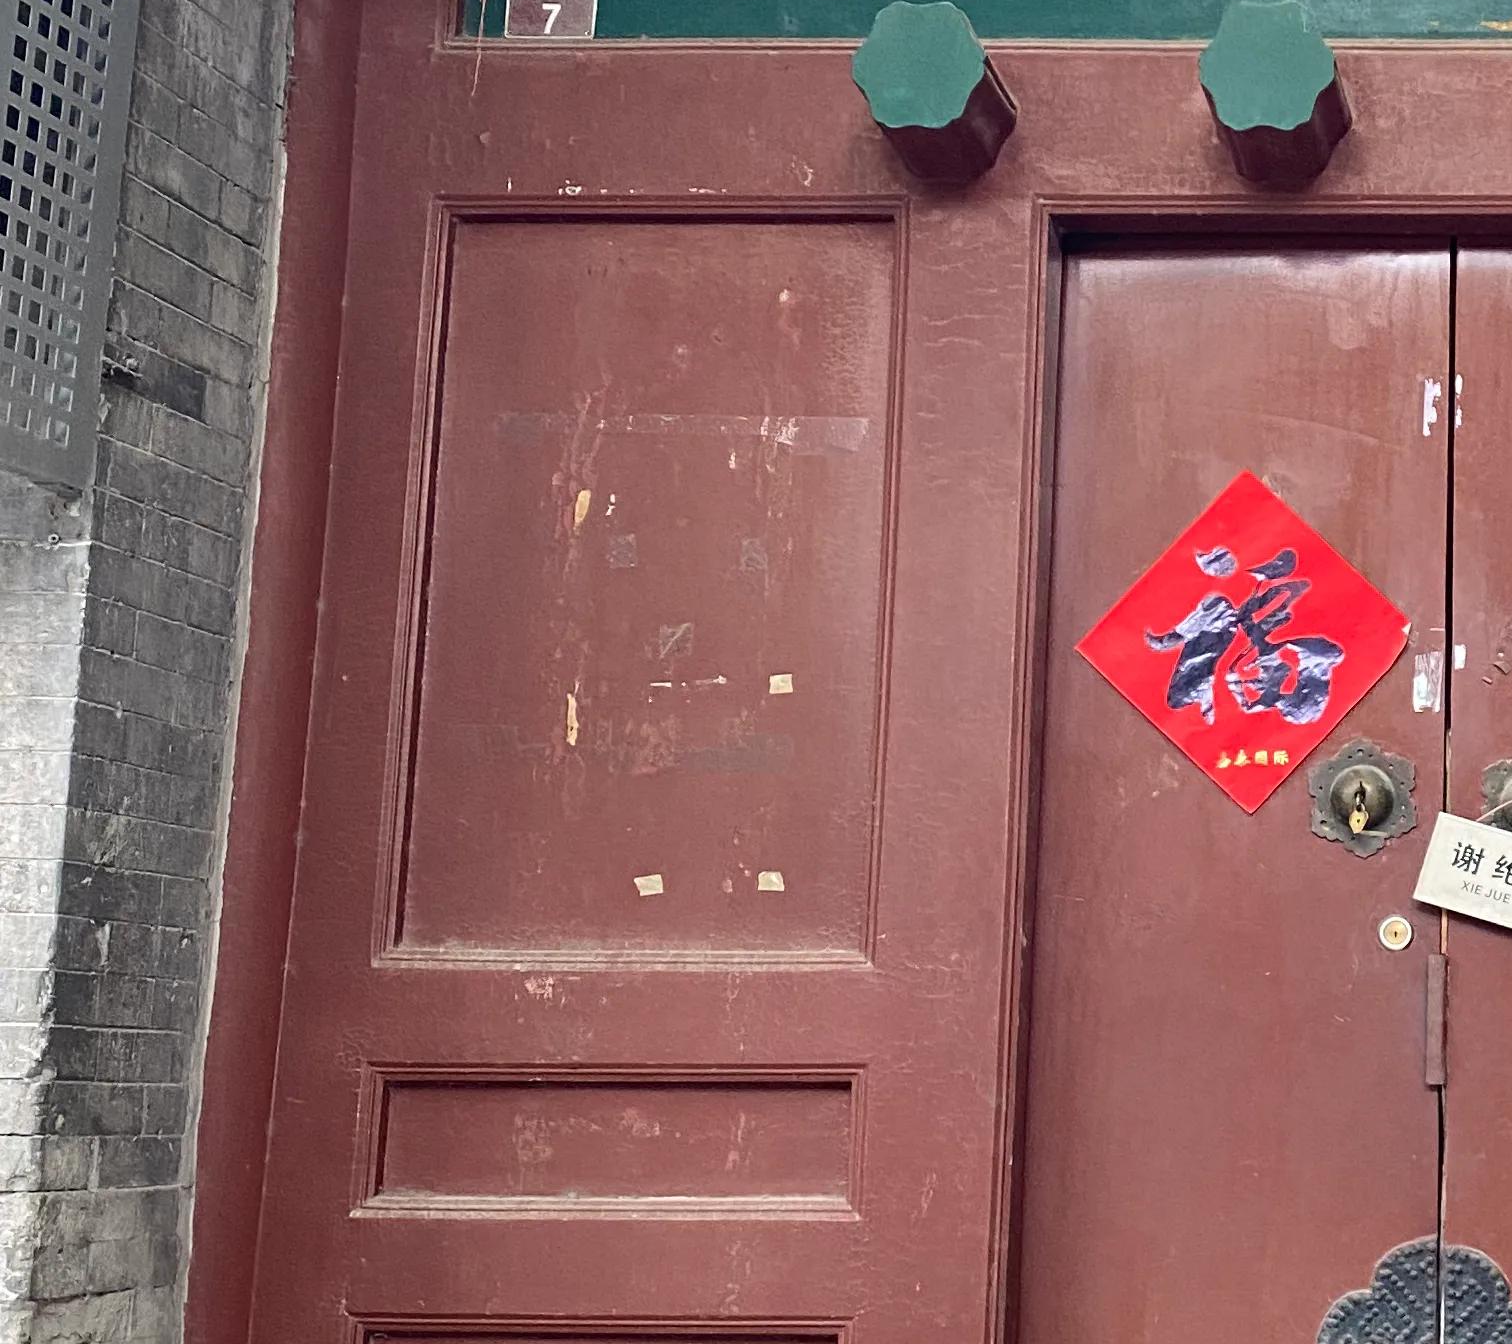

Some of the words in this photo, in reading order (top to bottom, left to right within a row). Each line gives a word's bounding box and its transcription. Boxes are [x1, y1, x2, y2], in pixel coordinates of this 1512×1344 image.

[542, 2, 561, 34] 7
[1144, 546, 1344, 725] 福
[1461, 880, 1480, 895] XIE
[1486, 890, 1510, 904] JUE
